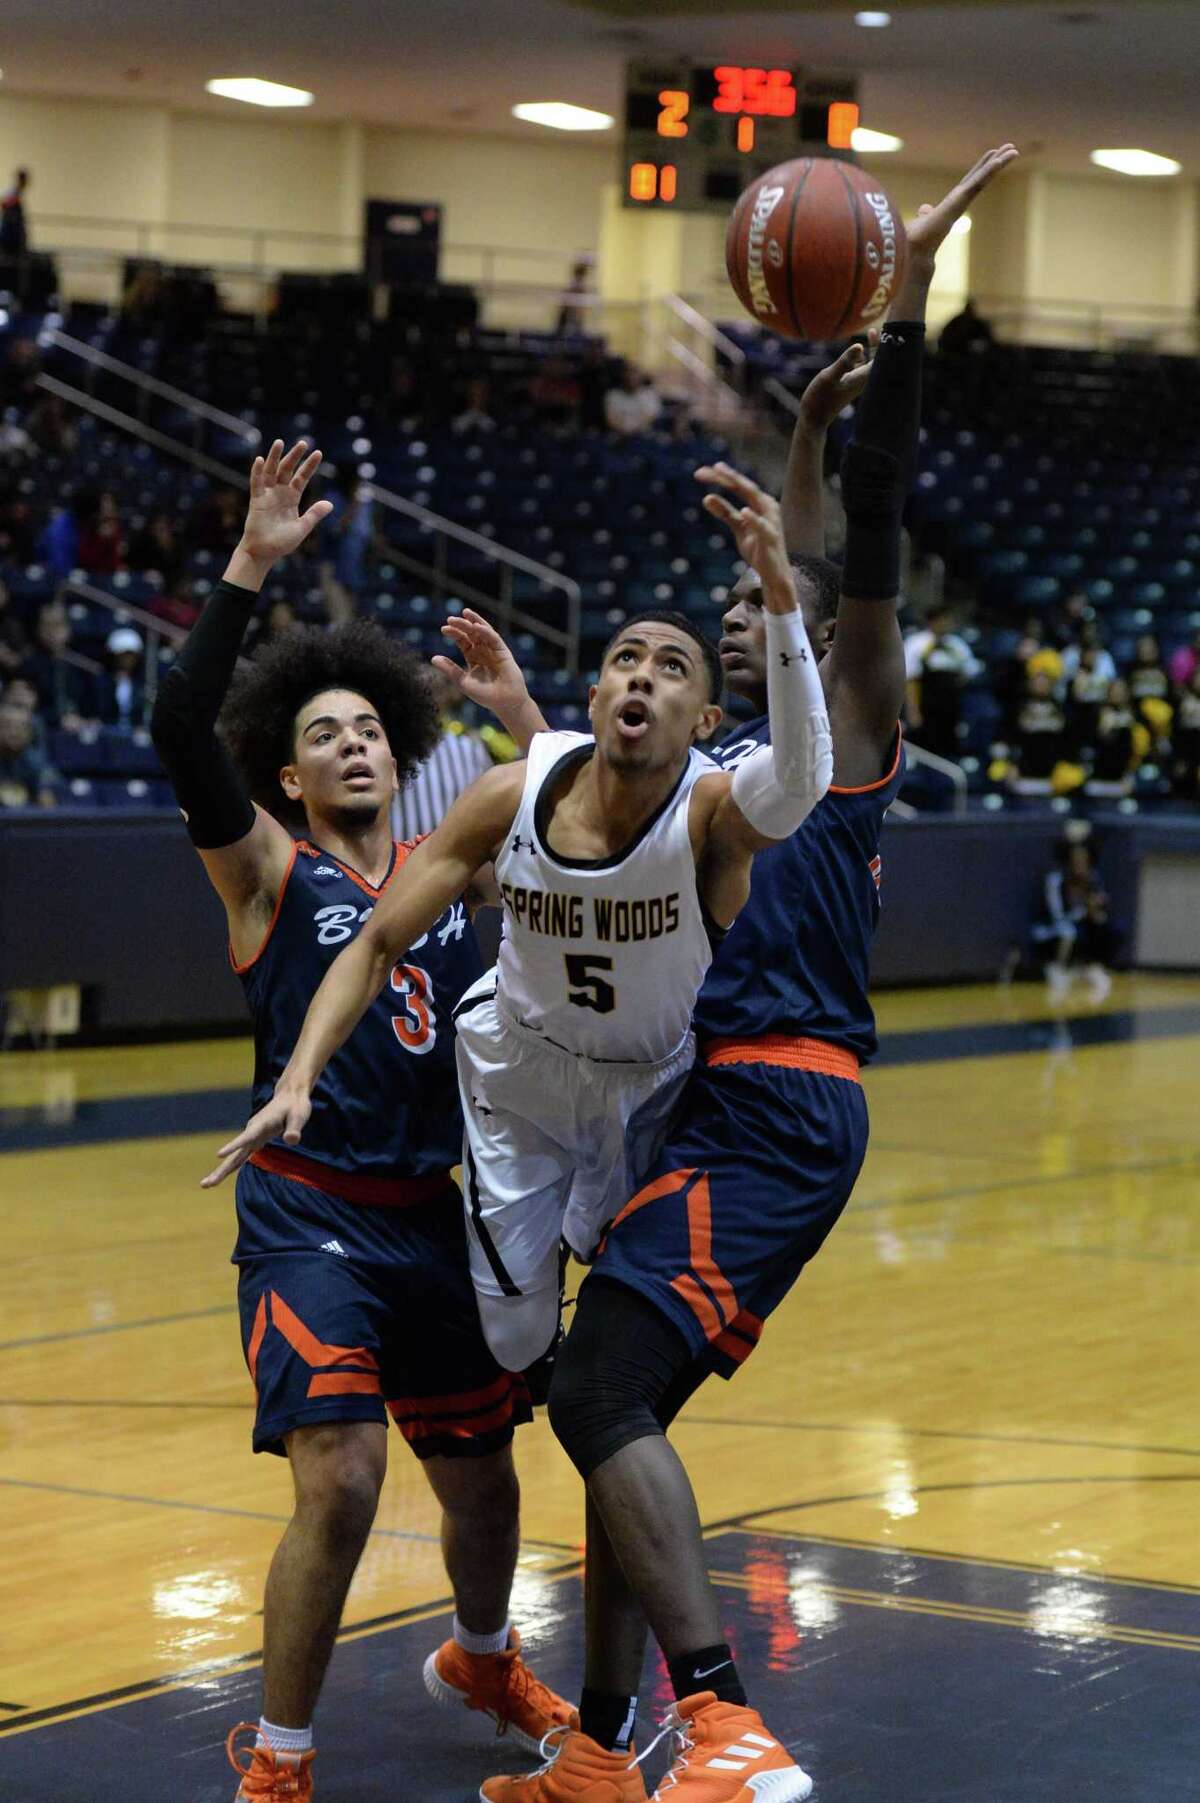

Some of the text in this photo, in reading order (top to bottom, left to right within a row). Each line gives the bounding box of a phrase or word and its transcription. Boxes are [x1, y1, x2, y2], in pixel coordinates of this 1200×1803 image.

[657, 91, 690, 138] 2
[747, 184, 784, 314] SPALDING
[861, 192, 896, 318] SPALDING
[501, 883, 583, 938] SPRING
[593, 893, 680, 943] WOODS
[390, 963, 437, 1055] 3
[564, 954, 616, 1014] 5
